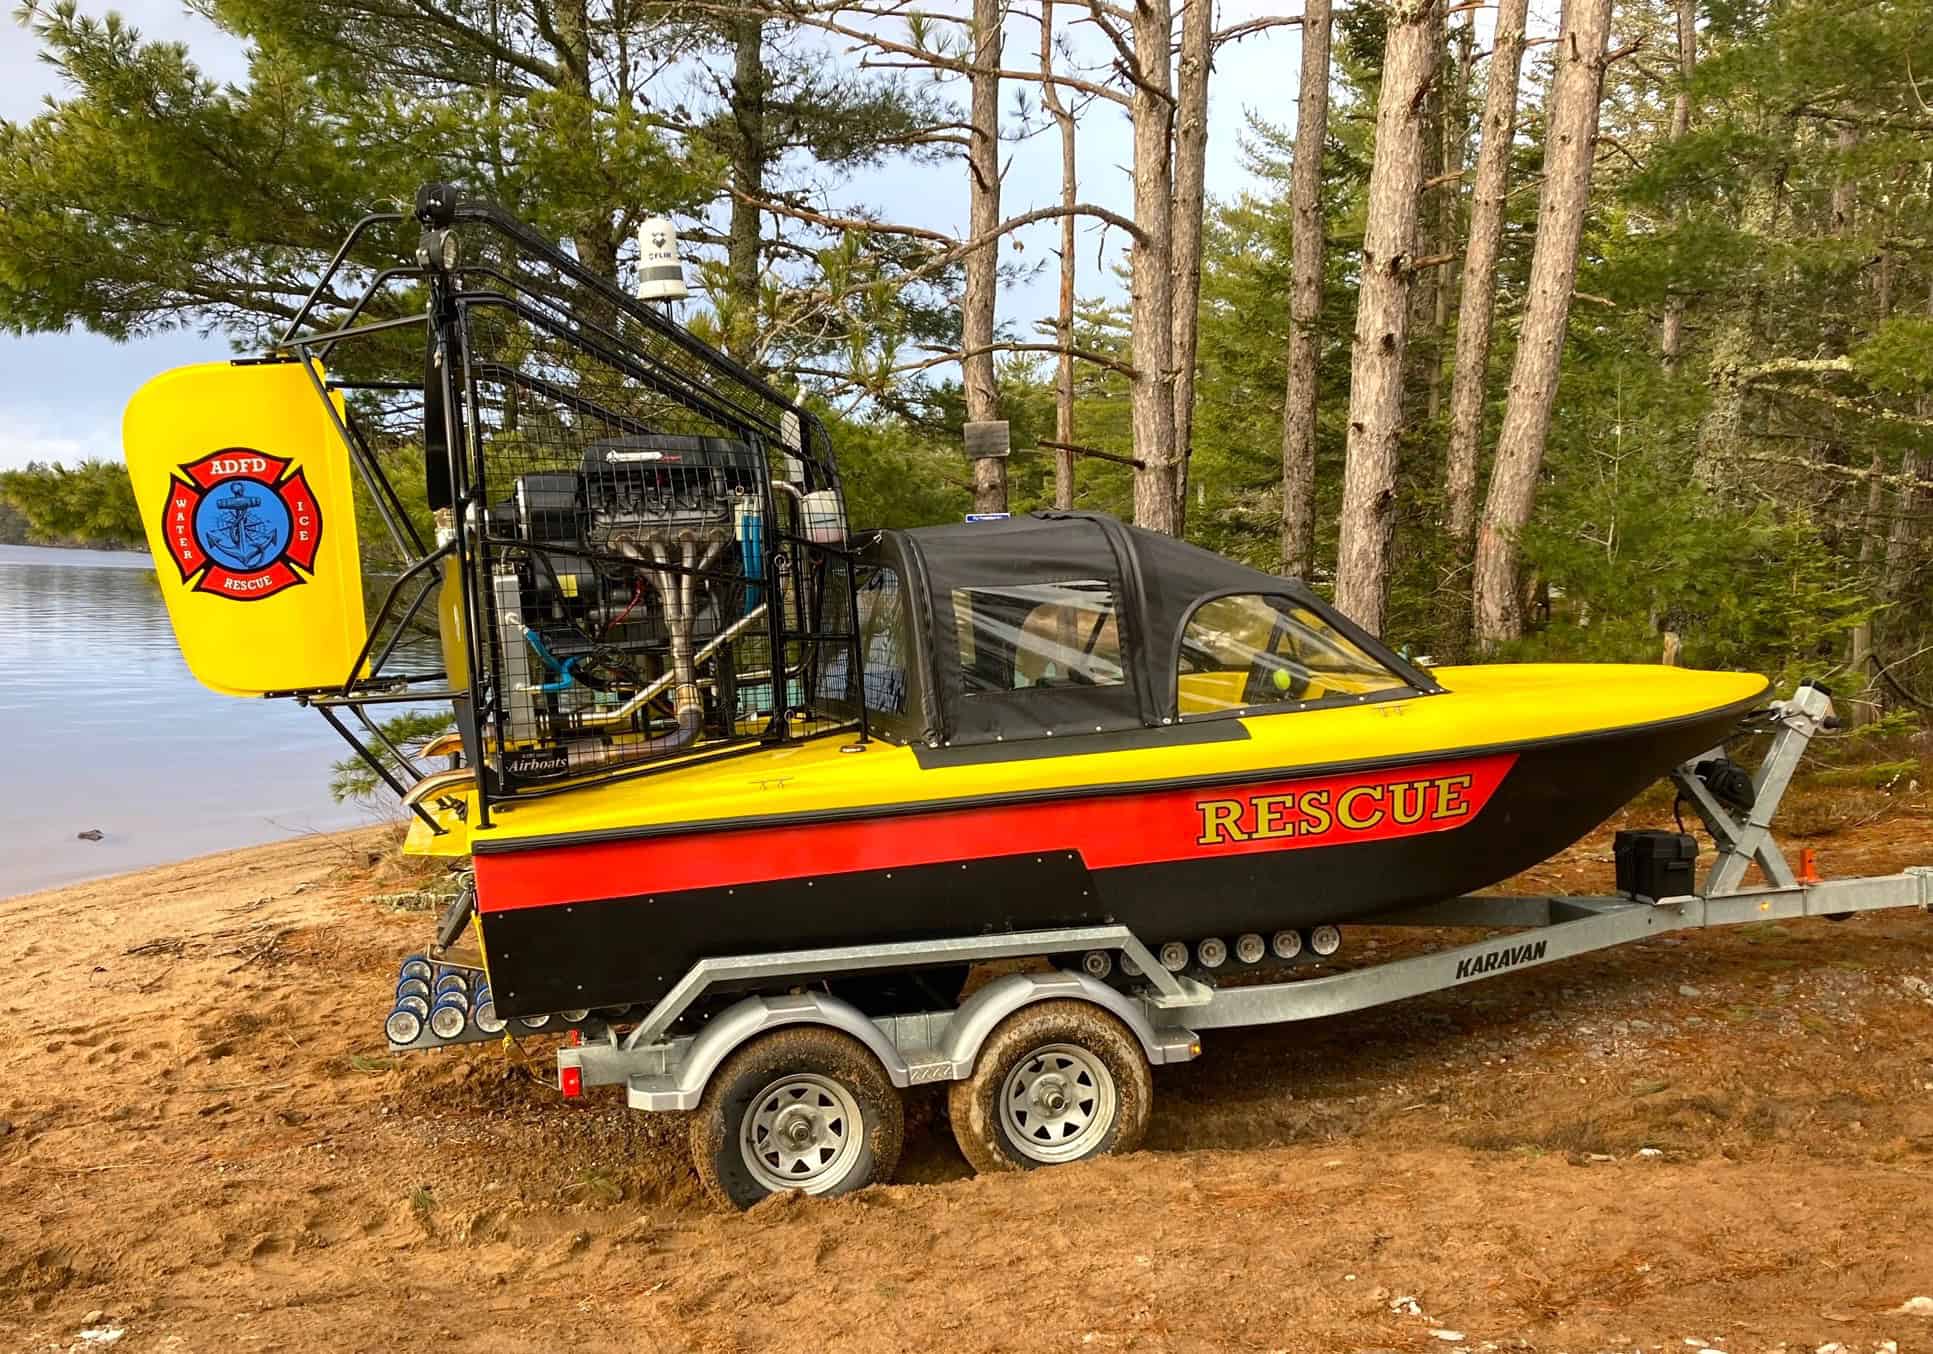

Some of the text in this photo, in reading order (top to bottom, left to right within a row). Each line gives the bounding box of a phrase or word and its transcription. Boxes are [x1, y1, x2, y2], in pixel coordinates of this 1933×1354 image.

[210, 458, 267, 475] ADFD
[175, 499, 193, 560] WATER
[296, 501, 310, 541] ICE
[223, 575, 273, 591] RESCUE
[508, 757, 568, 772] Airboats
[1196, 774, 1473, 845] RESCUE
[1456, 939, 1548, 980] KARAVAN
